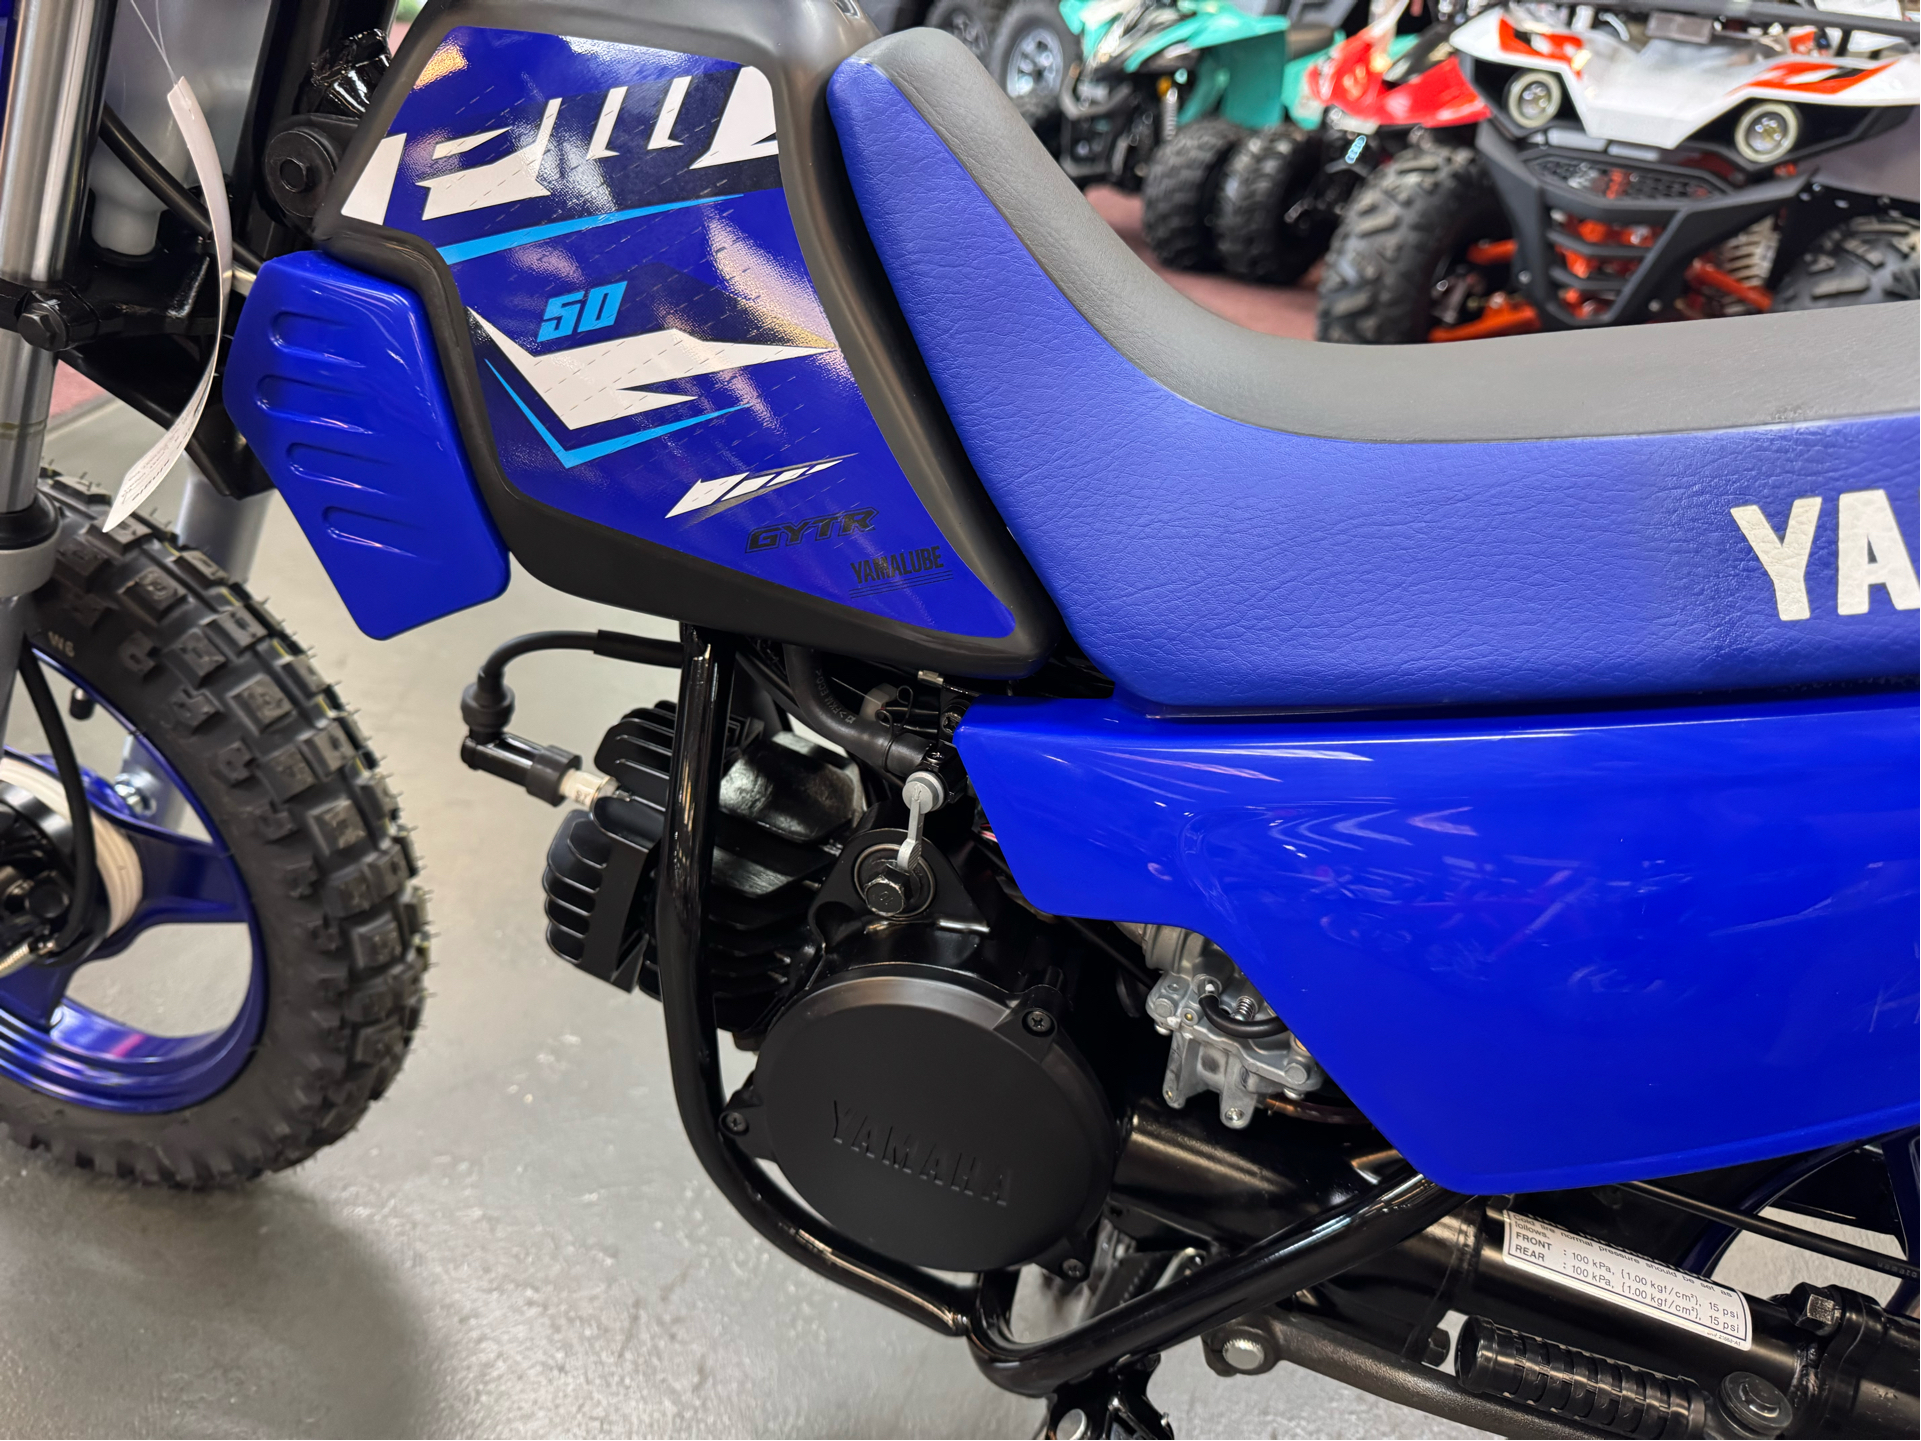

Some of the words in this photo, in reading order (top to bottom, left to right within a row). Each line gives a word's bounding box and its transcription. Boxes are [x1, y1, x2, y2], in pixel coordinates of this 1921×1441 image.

[537, 281, 628, 343] 50
[745, 507, 879, 553] GYTR
[850, 545, 944, 584] YAMALUBE
[1730, 489, 1920, 621] YA
[833, 1100, 1013, 1206] YAMAHA
[1515, 1231, 1552, 1251] FRONT
[1572, 1252, 1590, 1265] 100
[1592, 1259, 1615, 1276] kPa,
[1709, 1301, 1720, 1313] 15
[1722, 1308, 1739, 1320] psi
[1515, 1243, 1545, 1262] REAR
[1572, 1265, 1590, 1278] 100
[1592, 1272, 1615, 1289] kPa,
[1709, 1315, 1720, 1326] 15
[1722, 1322, 1740, 1334] psi
[1560, 1232, 1594, 1248] normal
[1598, 1245, 1640, 1265] pressure
[1645, 1262, 1678, 1278] should
